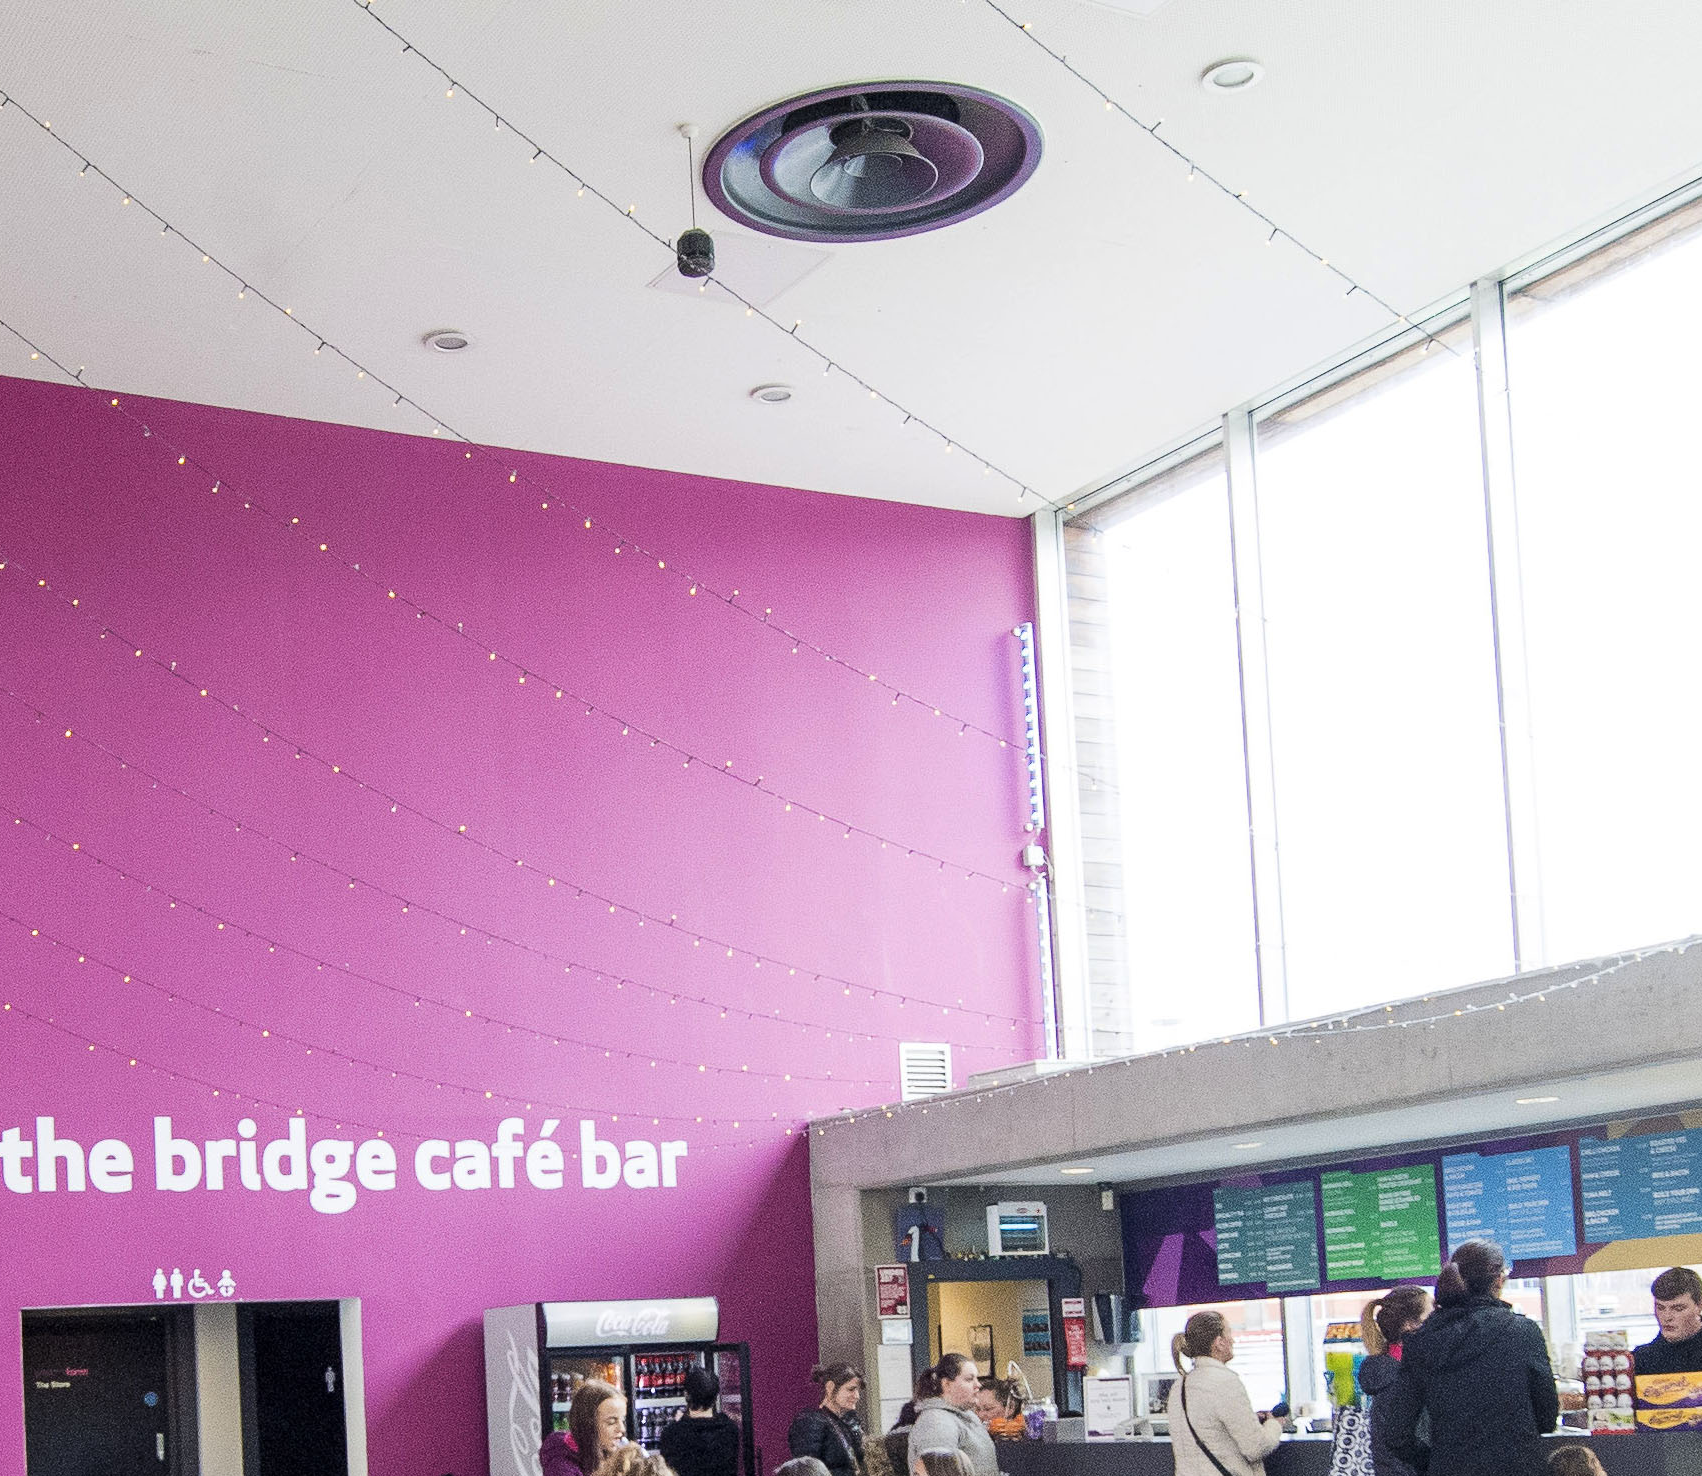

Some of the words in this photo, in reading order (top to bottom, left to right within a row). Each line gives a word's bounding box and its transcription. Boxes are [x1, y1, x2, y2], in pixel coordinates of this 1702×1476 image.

[153, 1116, 397, 1214] bridge
[415, 1119, 565, 1191] café
[579, 1119, 688, 1189] bar
